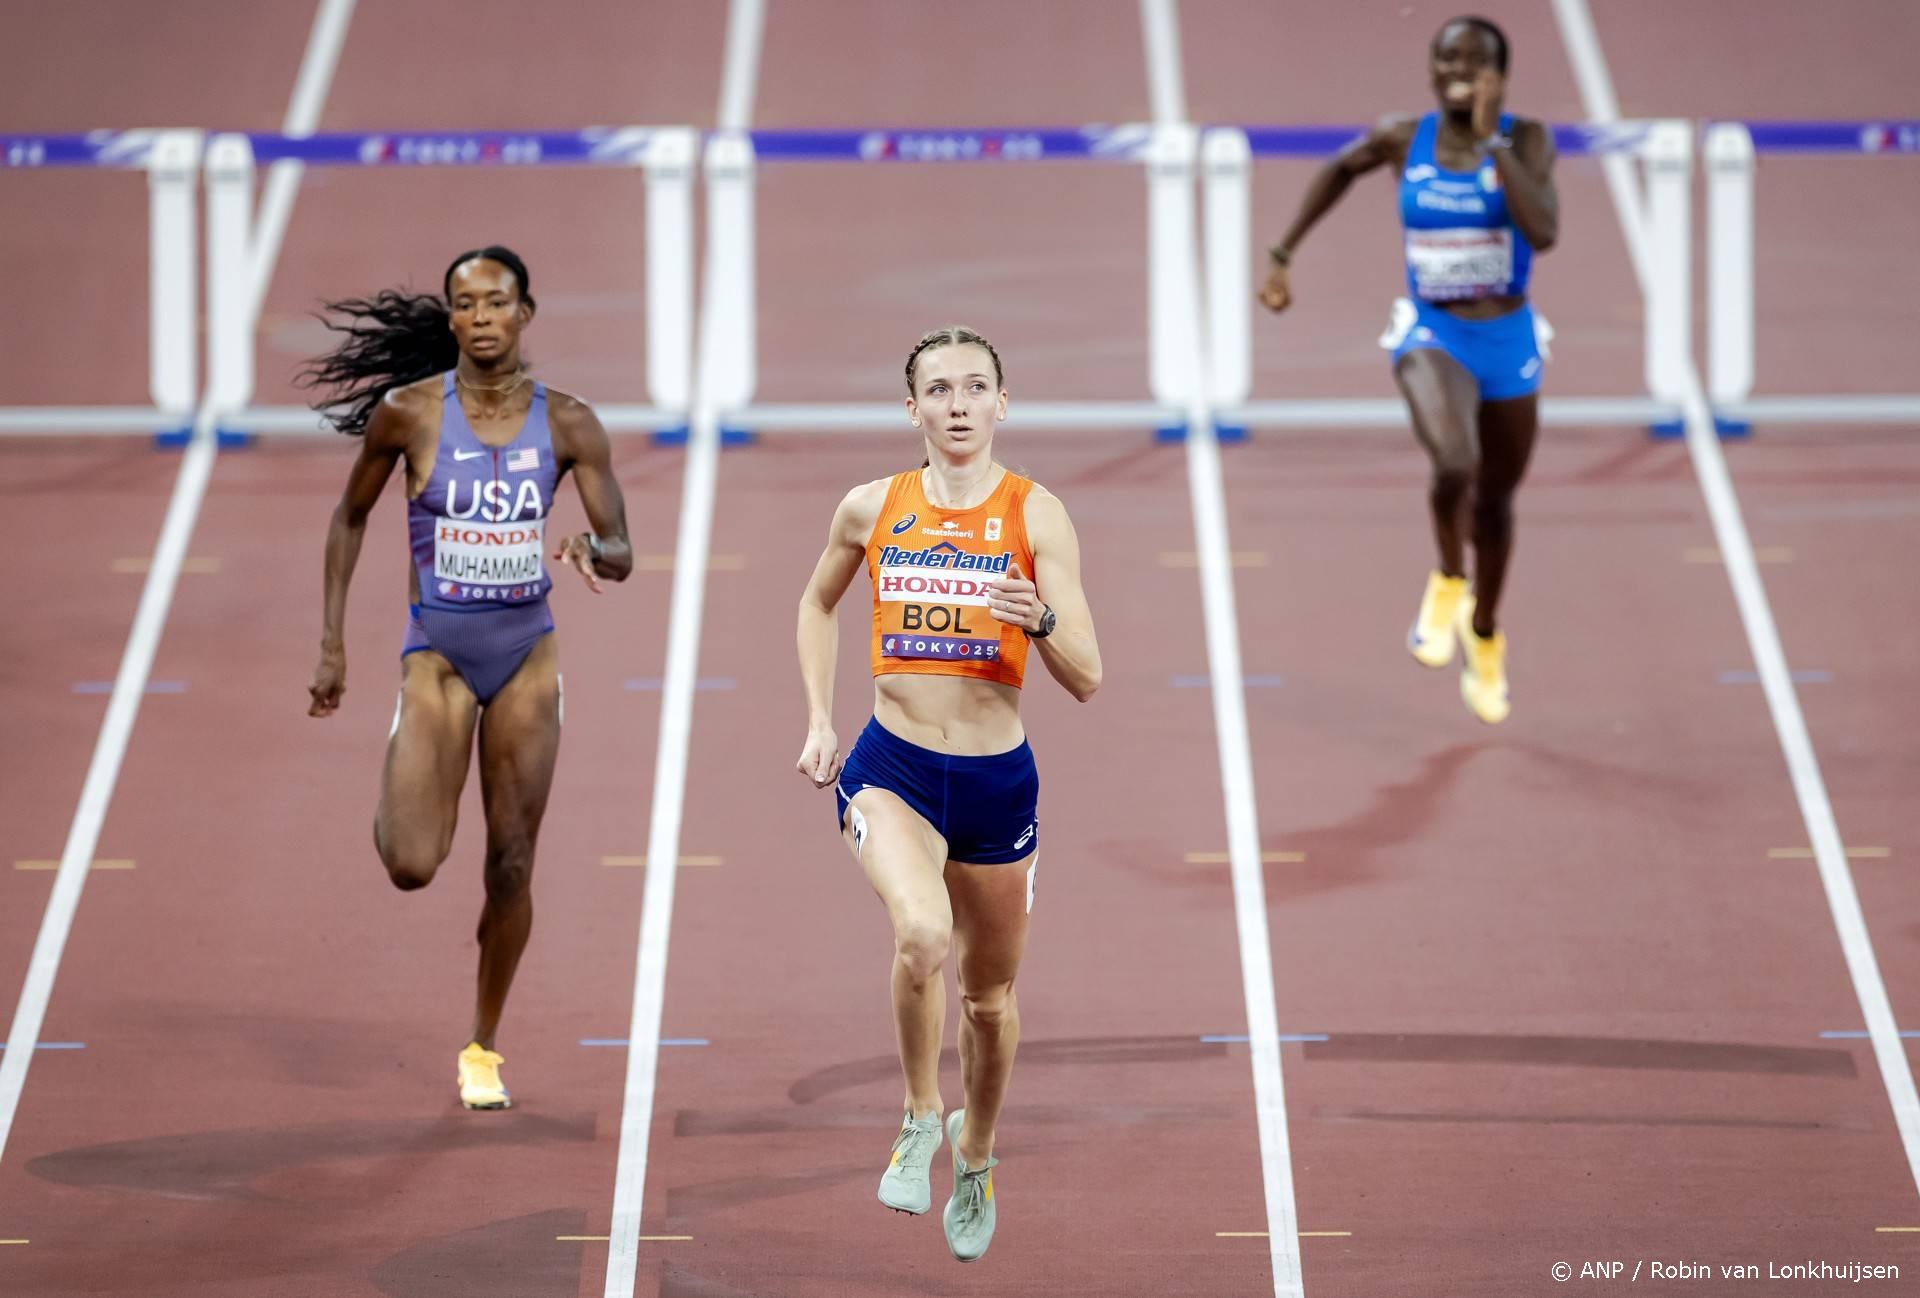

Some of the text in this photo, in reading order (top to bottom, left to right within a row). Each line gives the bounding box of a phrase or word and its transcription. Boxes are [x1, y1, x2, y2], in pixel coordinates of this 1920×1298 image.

[445, 479, 543, 522] USA
[440, 526, 539, 546] HONDA
[921, 527, 974, 539] Staatsloterij
[440, 551, 538, 580] MUHAMMAD
[902, 603, 972, 634] BOL
